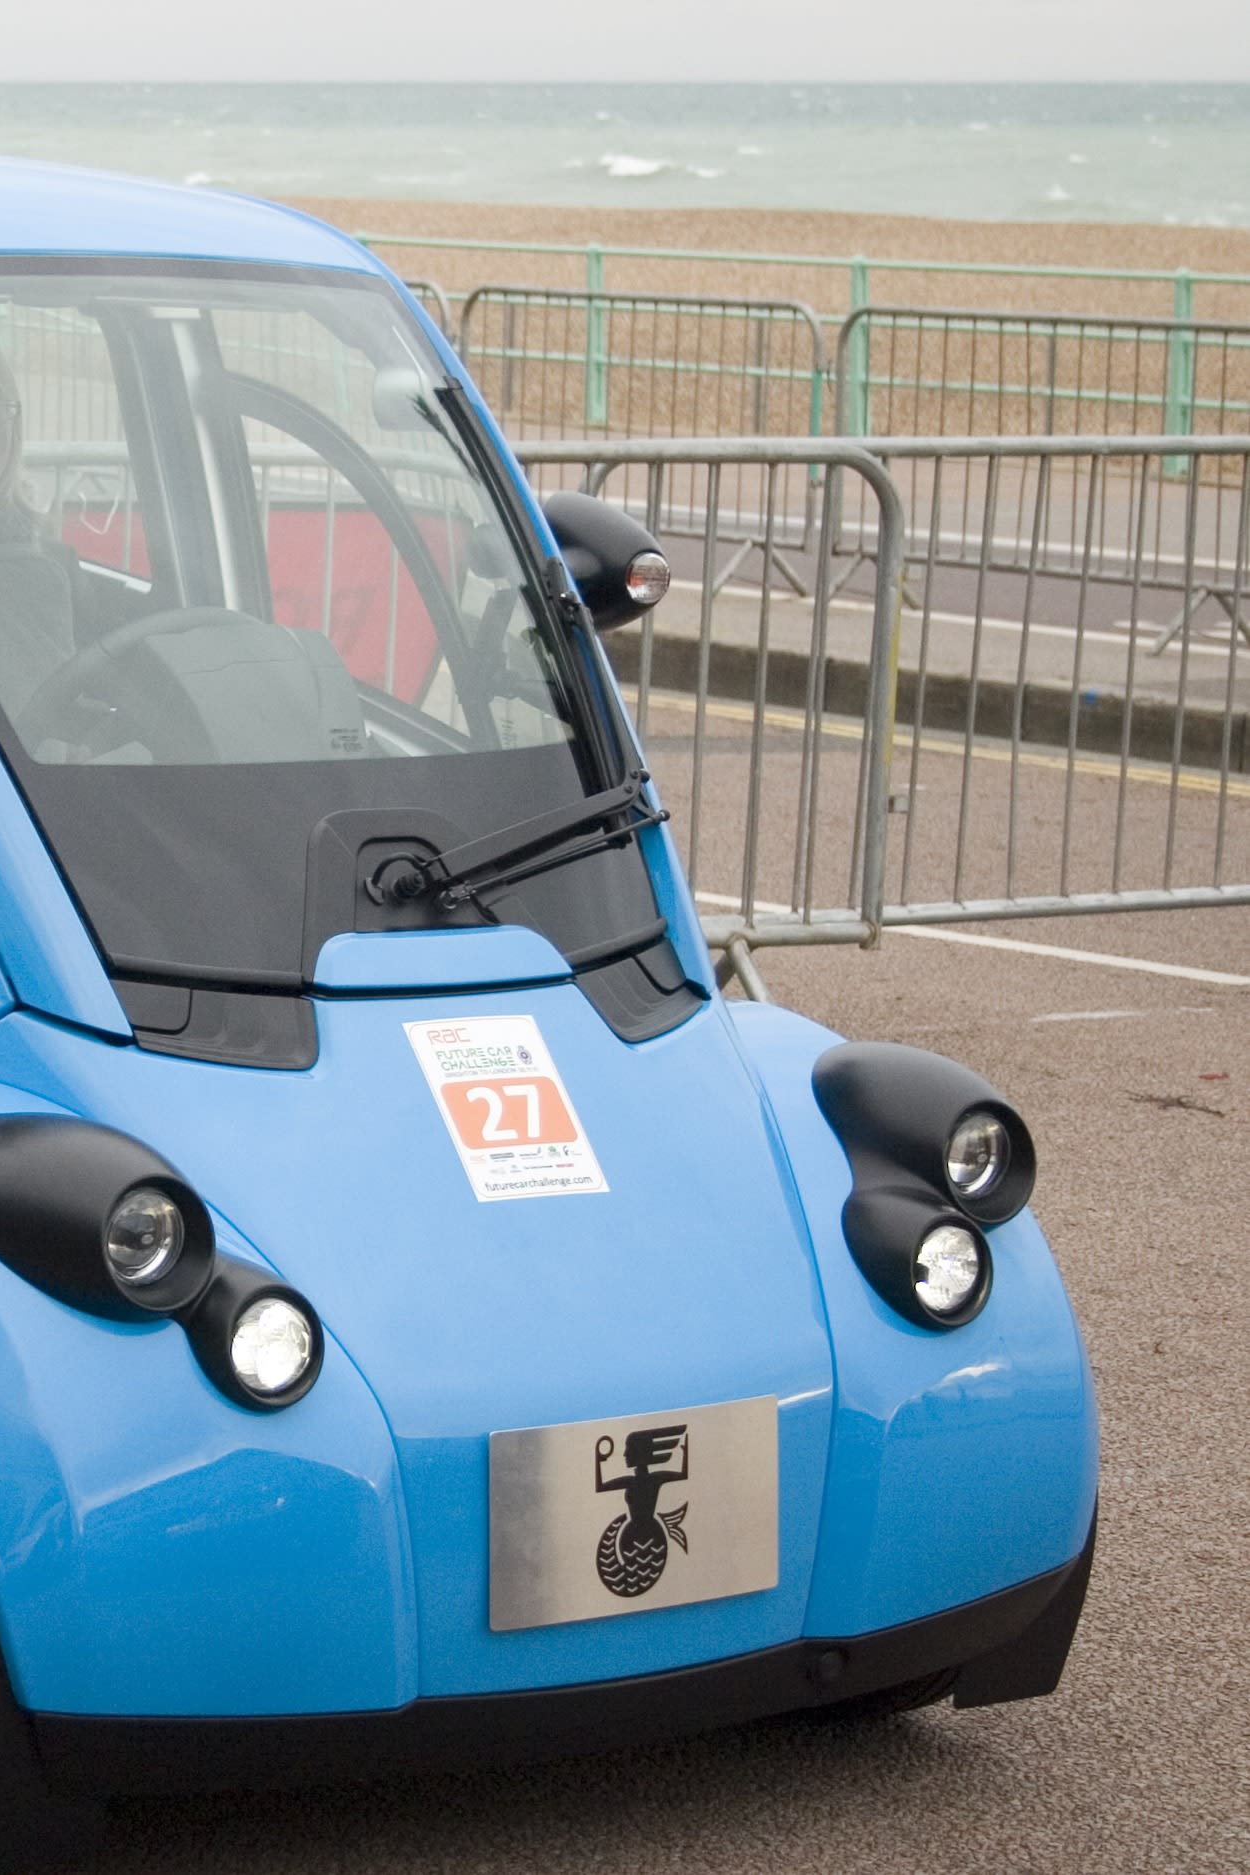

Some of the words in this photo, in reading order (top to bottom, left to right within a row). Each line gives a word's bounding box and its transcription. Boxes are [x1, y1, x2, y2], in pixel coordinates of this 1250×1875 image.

[436, 1048, 486, 1060] FUTURE
[487, 1046, 513, 1057] CAR
[466, 1084, 541, 1142] 27
[485, 1175, 594, 1192] futurecarchallenge.com
